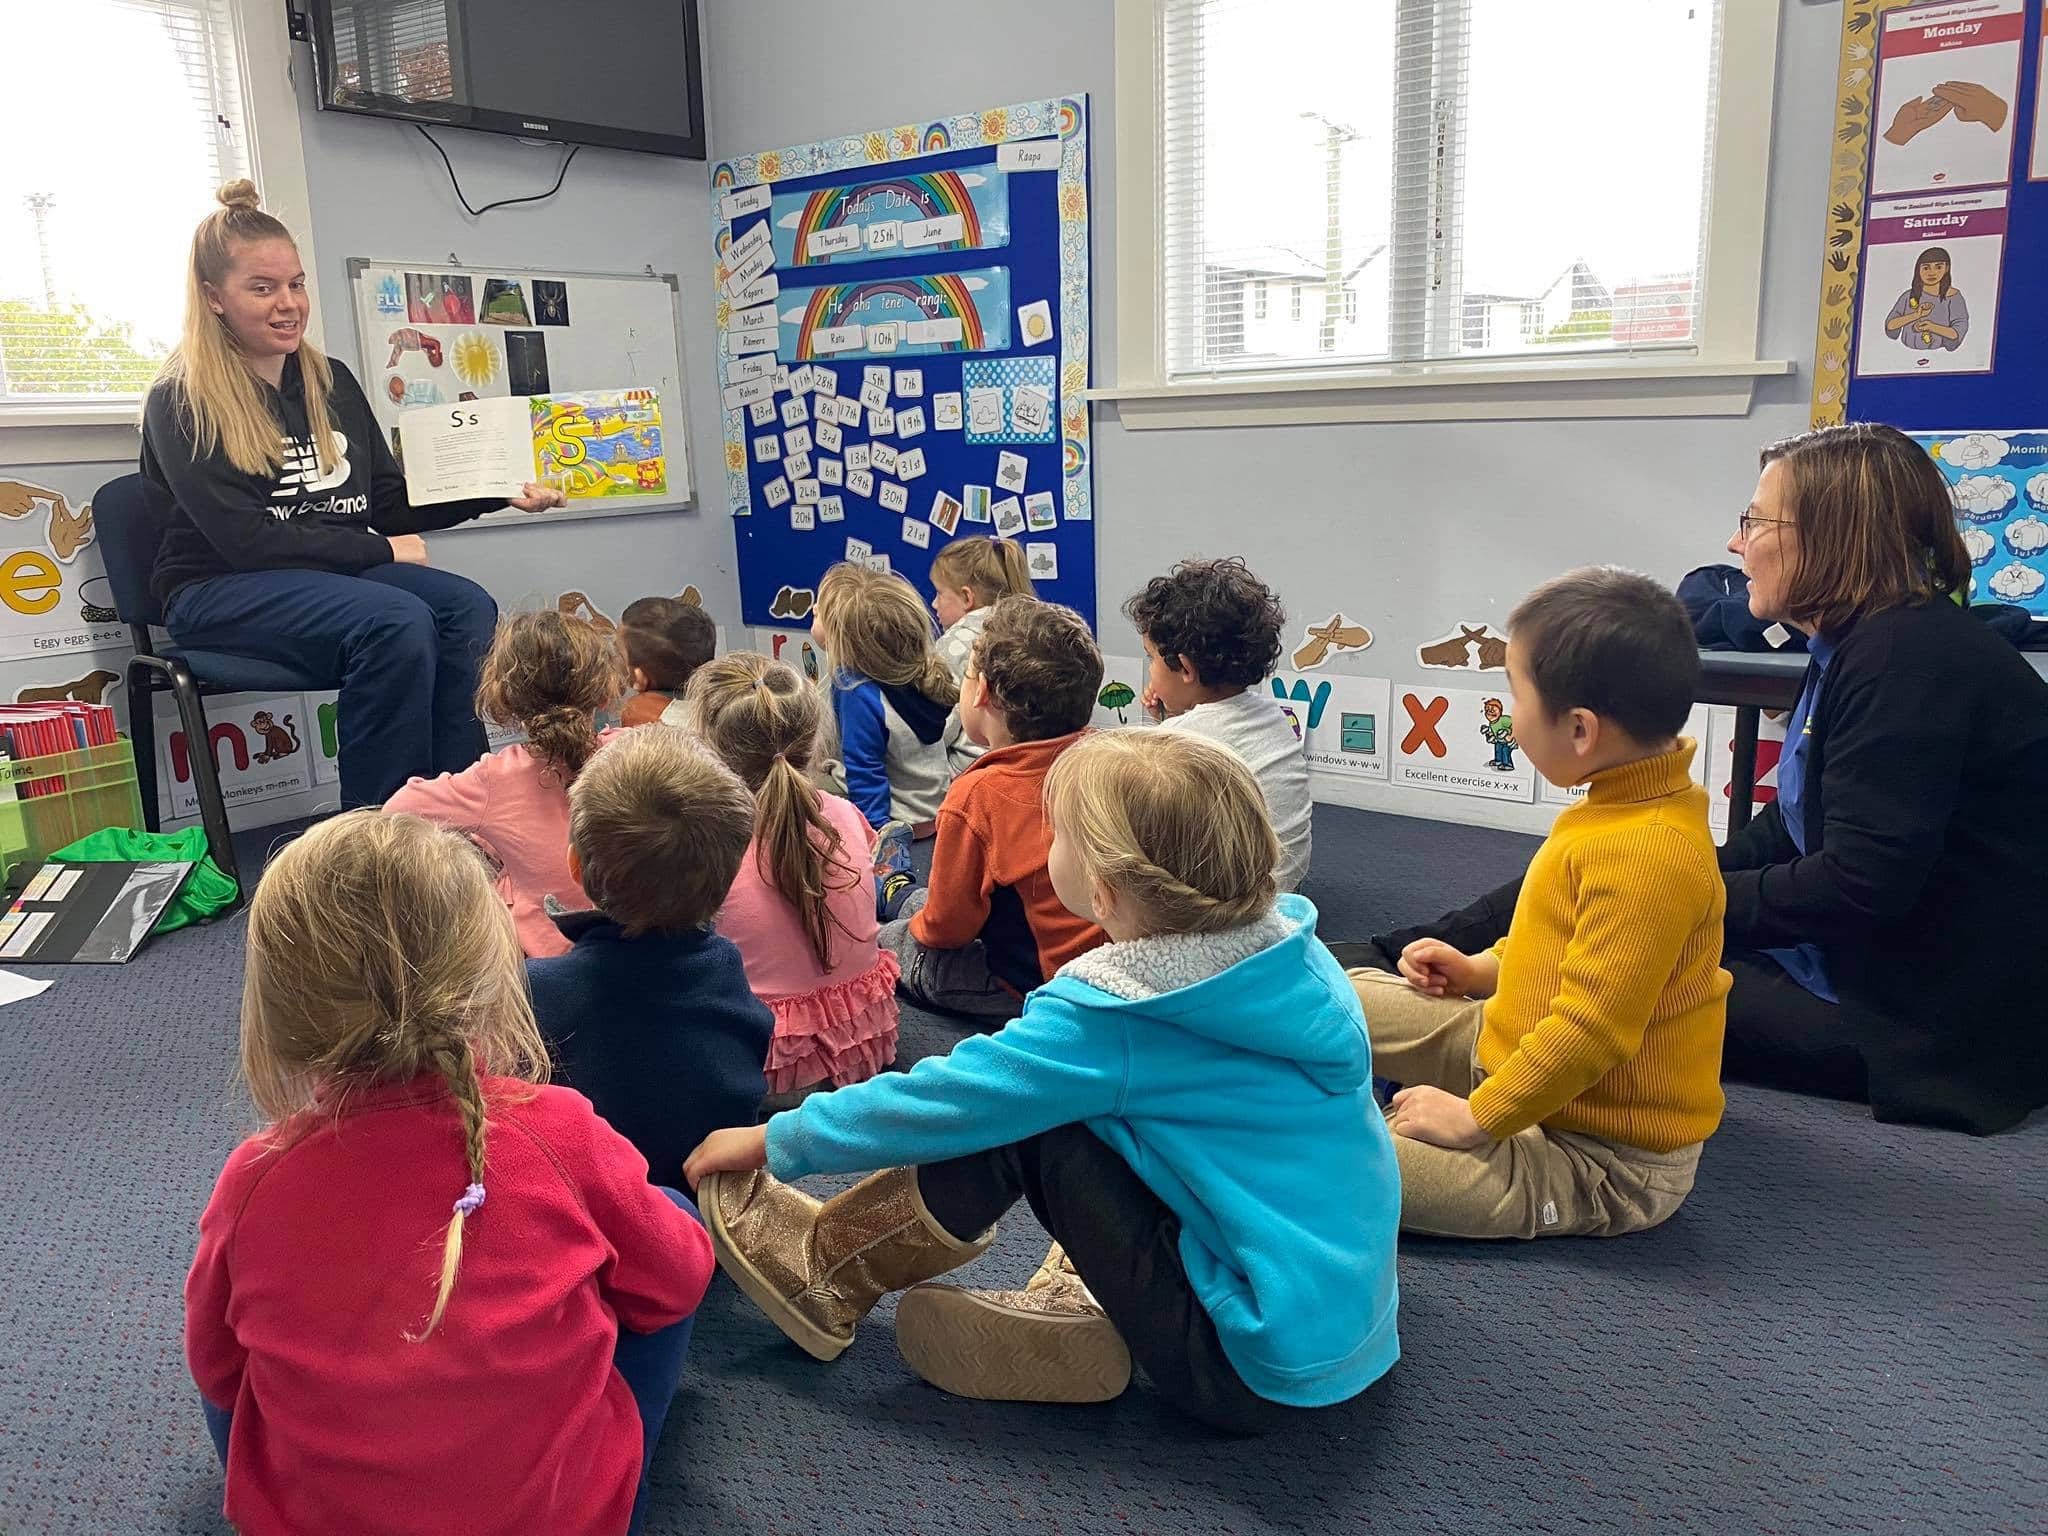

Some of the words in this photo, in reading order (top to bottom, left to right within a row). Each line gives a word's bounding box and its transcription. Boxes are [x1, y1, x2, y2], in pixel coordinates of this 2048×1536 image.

[1922, 22, 1983, 39] Monday
[733, 194, 760, 210] Tuesday
[839, 192, 876, 221] Today's
[885, 189, 912, 210] Date
[920, 190, 930, 205] is
[1903, 214, 1969, 229] Saturday
[818, 232, 849, 247] Thursday
[873, 229, 895, 244] 25th
[923, 223, 942, 239] June
[730, 233, 763, 261] Wednesday
[740, 259, 764, 283] Monday
[828, 296, 843, 314] He
[852, 293, 871, 312] aha
[915, 293, 947, 315] rangi:
[742, 312, 765, 327] March
[873, 331, 892, 346] 10th
[742, 361, 763, 375] Friday
[794, 373, 811, 391] 11th
[815, 373, 834, 390] 28th
[872, 373, 885, 386] 5th
[902, 377, 917, 391] 7th
[867, 390, 881, 405] 4th
[754, 403, 773, 420] 23rd
[787, 404, 805, 419] 12th
[820, 402, 834, 417] 8th
[840, 404, 857, 420] 17th
[873, 415, 891, 429] 14th
[902, 414, 922, 431] 19th
[551, 415, 587, 466] S
[793, 435, 806, 448] 1st
[821, 428, 837, 445] 3rd
[760, 441, 776, 456] 18th
[850, 450, 867, 465] 13th
[873, 449, 895, 467] 22nd
[790, 459, 807, 475] 16th
[825, 465, 837, 478] 6th
[901, 458, 921, 474] 31st
[850, 473, 869, 490] 29th
[769, 484, 786, 501] 15th
[799, 485, 817, 498] 24th
[883, 489, 903, 506] 30th
[823, 502, 840, 516] 26th
[1964, 511, 2003, 521] ebruary
[794, 511, 811, 524] 20th
[906, 525, 926, 542] 21st
[2014, 549, 2038, 557] July
[0, 550, 62, 615] e
[33, 637, 60, 650] Eggy
[64, 634, 90, 645] eggs
[92, 630, 122, 641] e-e-e
[772, 634, 788, 661] r
[1306, 752, 1348, 766] windows
[1349, 759, 1381, 770] w-w-w
[1405, 768, 1448, 783] Excellent
[1450, 775, 1492, 789] exercise
[1494, 780, 1519, 792] x-x-x
[222, 784, 265, 800] Monkeys
[265, 777, 300, 791] m-m-m
